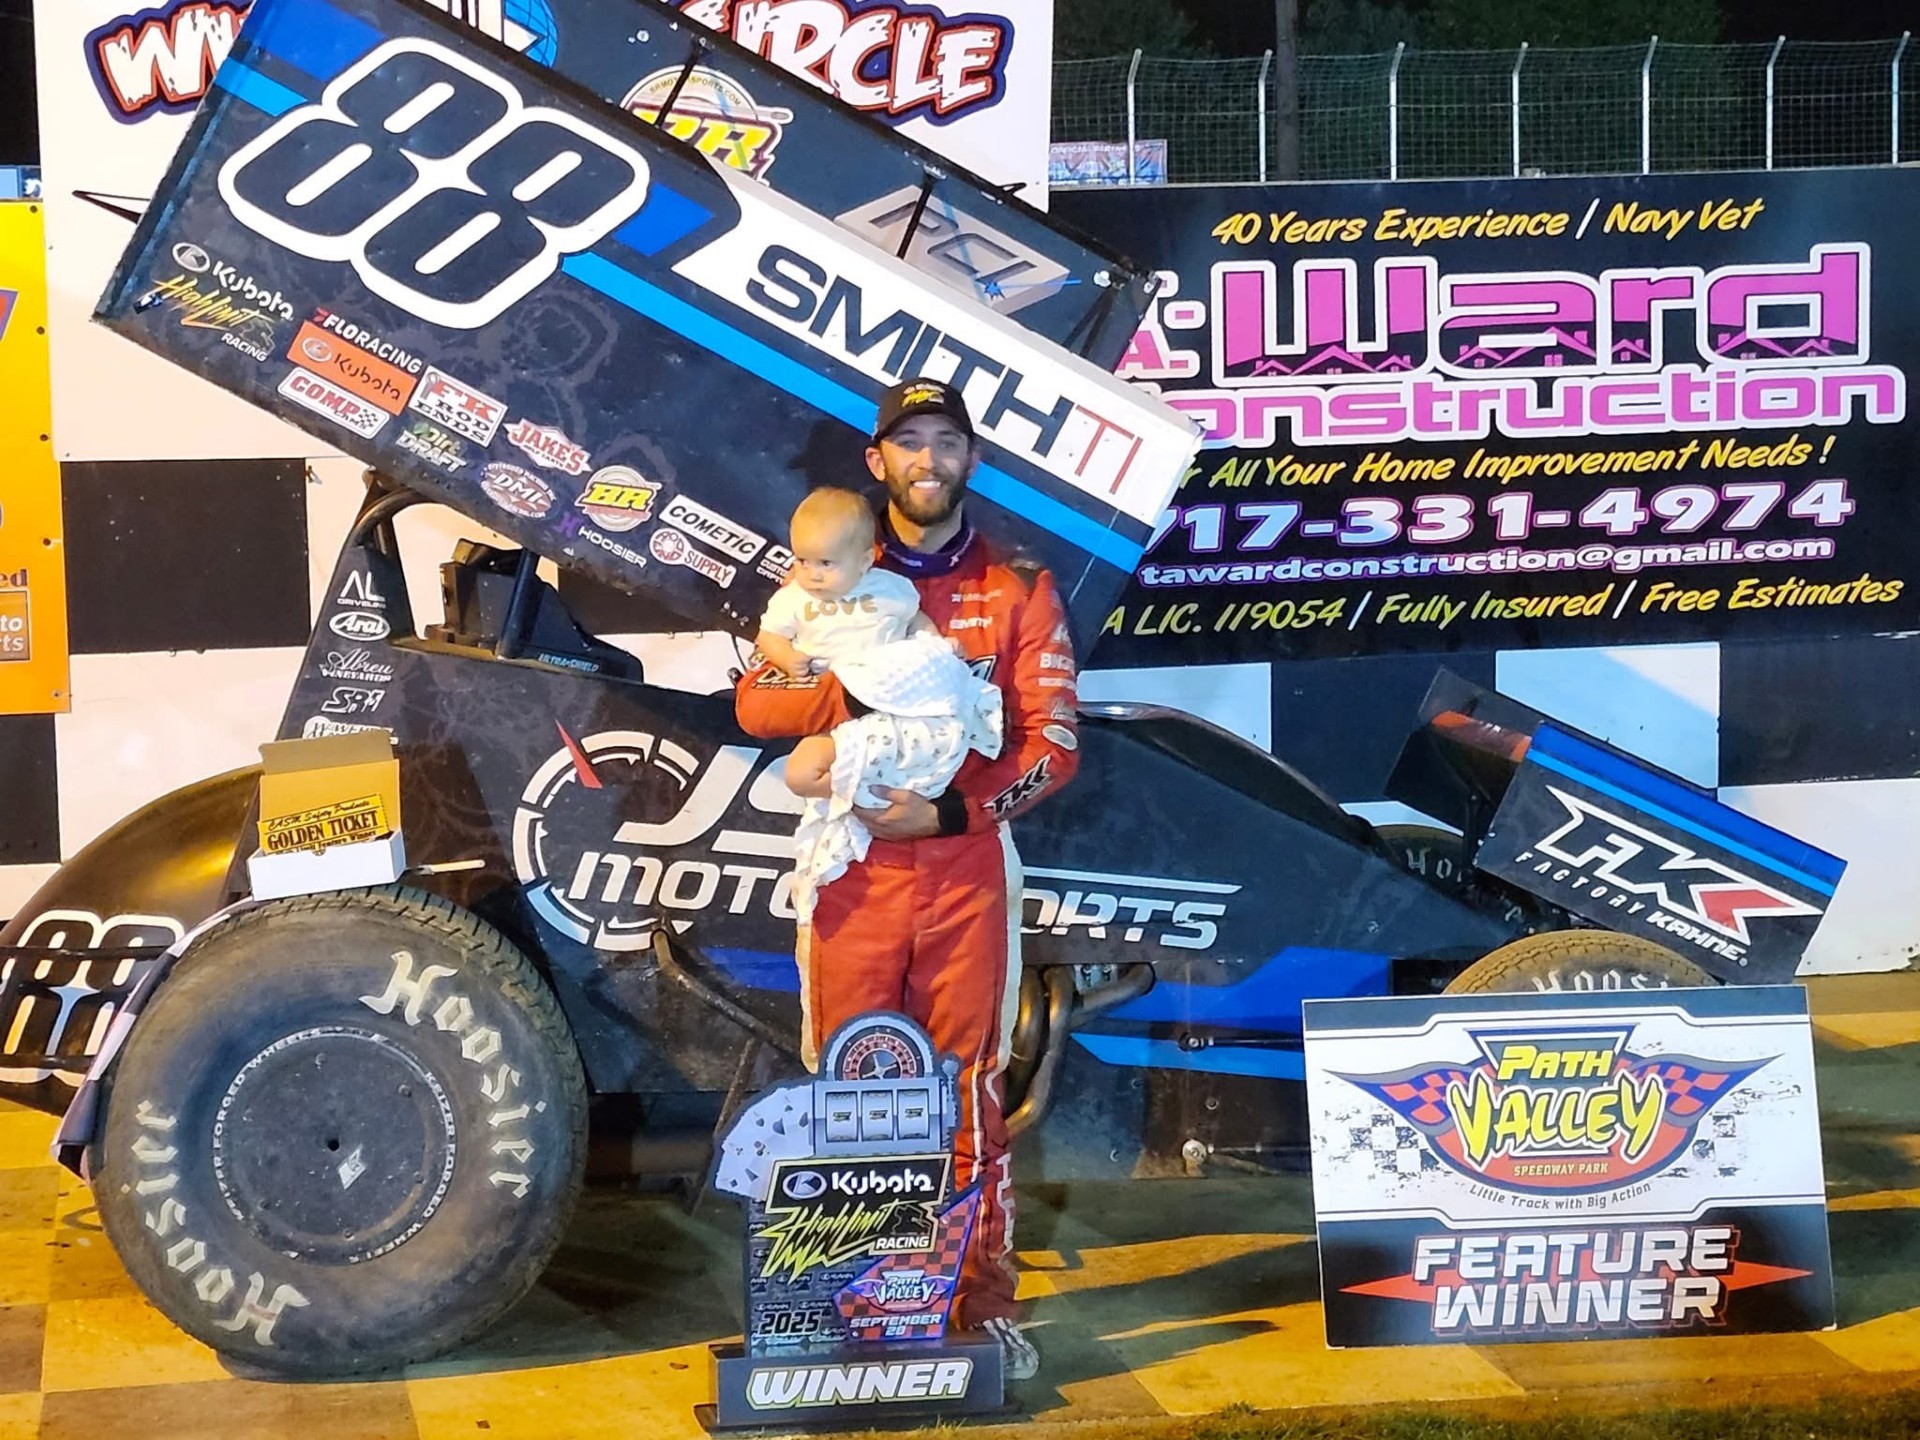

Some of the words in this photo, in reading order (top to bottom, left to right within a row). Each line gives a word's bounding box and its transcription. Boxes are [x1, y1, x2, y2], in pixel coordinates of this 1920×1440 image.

[217, 36, 645, 330] 88
[1211, 212, 1262, 245] 40
[1269, 209, 1368, 244] Years
[1374, 207, 1570, 247] Experience
[1574, 197, 1601, 240] /
[1602, 201, 1695, 241] Navy
[1697, 197, 1766, 232] Vet
[212, 260, 295, 321] Kubota
[1211, 242, 1872, 387] Ward
[220, 332, 268, 362] RACING
[745, 243, 1075, 459] SMITH
[289, 374, 361, 415] COMP
[334, 353, 400, 400] Kubota
[414, 400, 487, 442] ENDS
[430, 380, 498, 423] FK
[435, 400, 490, 432] ROD
[1158, 364, 1907, 449] onstruction
[395, 430, 467, 473] DRAFT
[513, 423, 585, 474] JAKE'S
[1208, 456, 1261, 489] All
[1265, 453, 1346, 487] Your
[1352, 451, 1456, 485] Home
[1463, 437, 1701, 485] Improvement
[1699, 433, 1815, 470] Needs
[493, 473, 542, 507] DMI
[581, 482, 653, 511] BR
[578, 526, 648, 569] HOOSIER
[668, 505, 756, 555] COMETIC
[684, 550, 732, 582] SUPPLY
[1137, 537, 1835, 590] tawardconstruction@gmail.com
[334, 614, 385, 635] Arai
[803, 594, 879, 622] LOVE
[1133, 602, 1202, 636] LIC.
[1213, 596, 1347, 632] 119054
[1375, 592, 1465, 631] Fully
[1470, 582, 1614, 620] Insured
[1639, 580, 1719, 614] Free
[1727, 572, 1904, 611] Estimates
[267, 824, 325, 851] GOLDEN
[327, 810, 378, 836] TICKET
[1514, 851, 1646, 916] FACTORY
[1645, 910, 1747, 963] KAHNE
[1497, 1044, 1616, 1081] PATH
[213, 1073, 246, 1149] FORGED
[425, 1071, 456, 1138] KEIZER
[1447, 1070, 1665, 1171] VALLEY
[831, 1167, 935, 1196] Kubota
[1513, 1163, 1576, 1177] SPEEDWAY
[1578, 1162, 1609, 1175] PARK
[1469, 1184, 1506, 1205] Little
[1511, 1195, 1550, 1210] Track
[1554, 1197, 1583, 1209] with
[1586, 1195, 1607, 1209] Big
[1611, 1182, 1651, 1204] Action
[875, 1235, 930, 1250] RACING
[1413, 1228, 1733, 1283] FEATURE
[873, 1282, 936, 1305] VALLEY
[1433, 1276, 1722, 1329] WINNER
[760, 1310, 821, 1335] 2025
[849, 1313, 942, 1329] SEPTEMBER
[749, 1359, 972, 1408] WINNER
